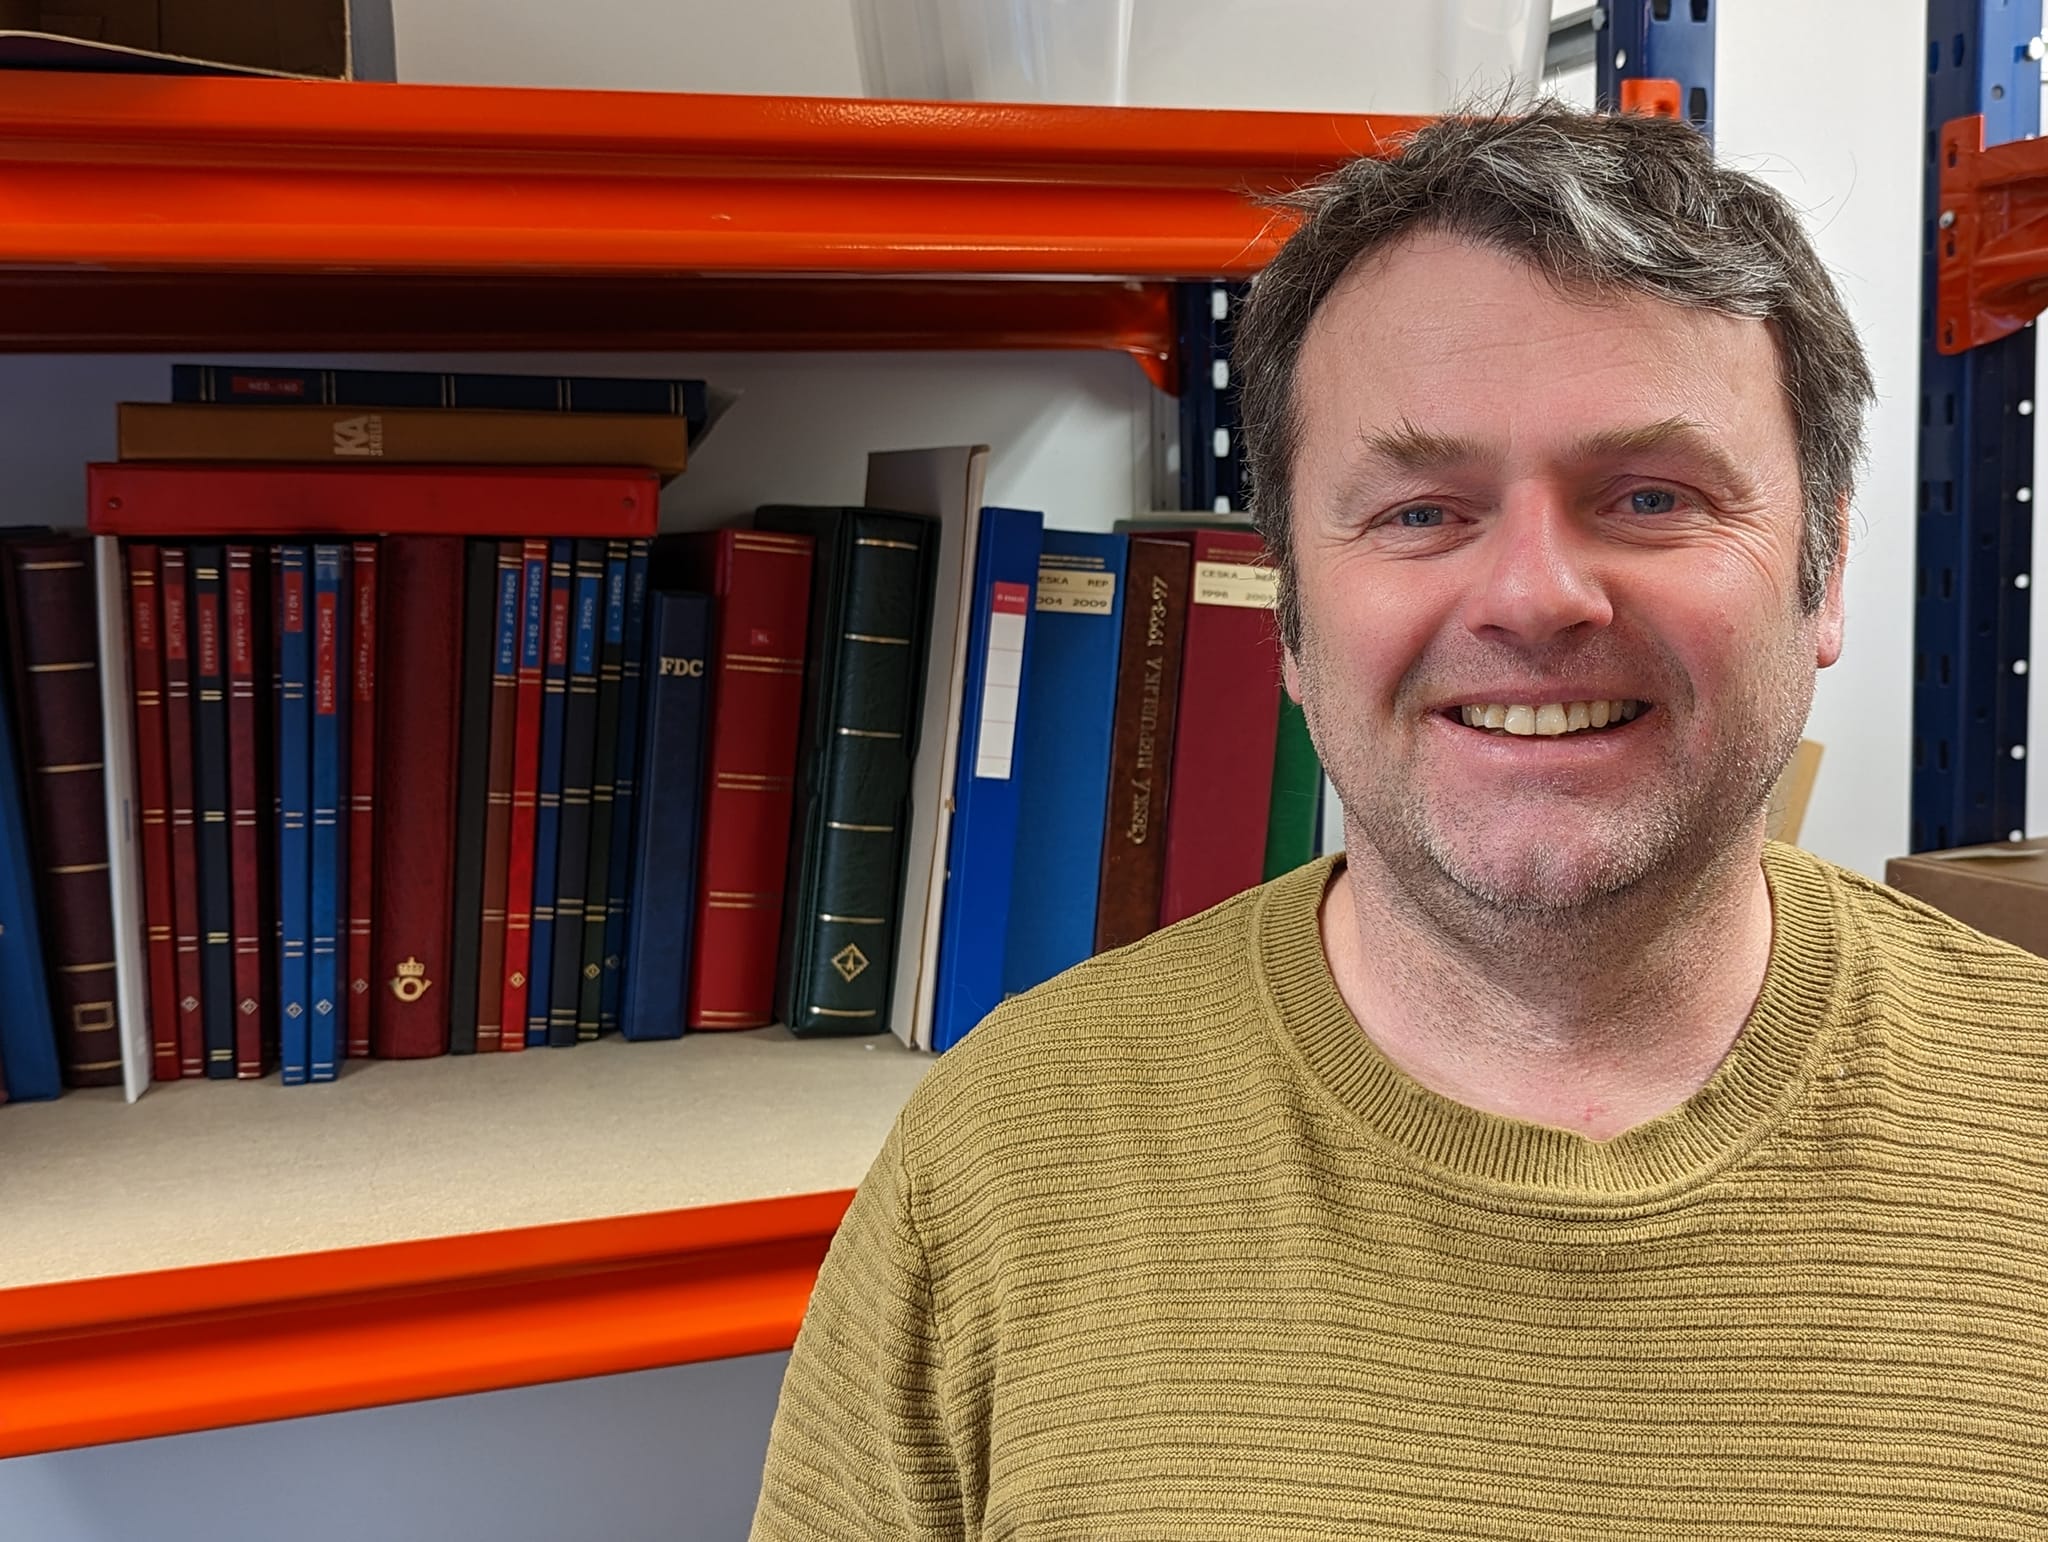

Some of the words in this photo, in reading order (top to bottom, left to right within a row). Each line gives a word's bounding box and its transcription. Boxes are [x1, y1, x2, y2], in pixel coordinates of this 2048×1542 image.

[333, 416, 369, 456] KA
[1040, 577, 1069, 585] ESKA
[1088, 579, 1109, 587] REP
[1202, 569, 1238, 579] CESKA
[288, 589, 299, 623] INDIA
[1038, 598, 1062, 606] 004
[1073, 600, 1107, 608] 2009
[1147, 576, 1168, 647] 1993-97
[321, 608, 332, 649] BHOPAL
[658, 656, 704, 677] FDC
[1136, 656, 1163, 769] REPUBLIKA
[1126, 777, 1151, 845] ČESKÁ
